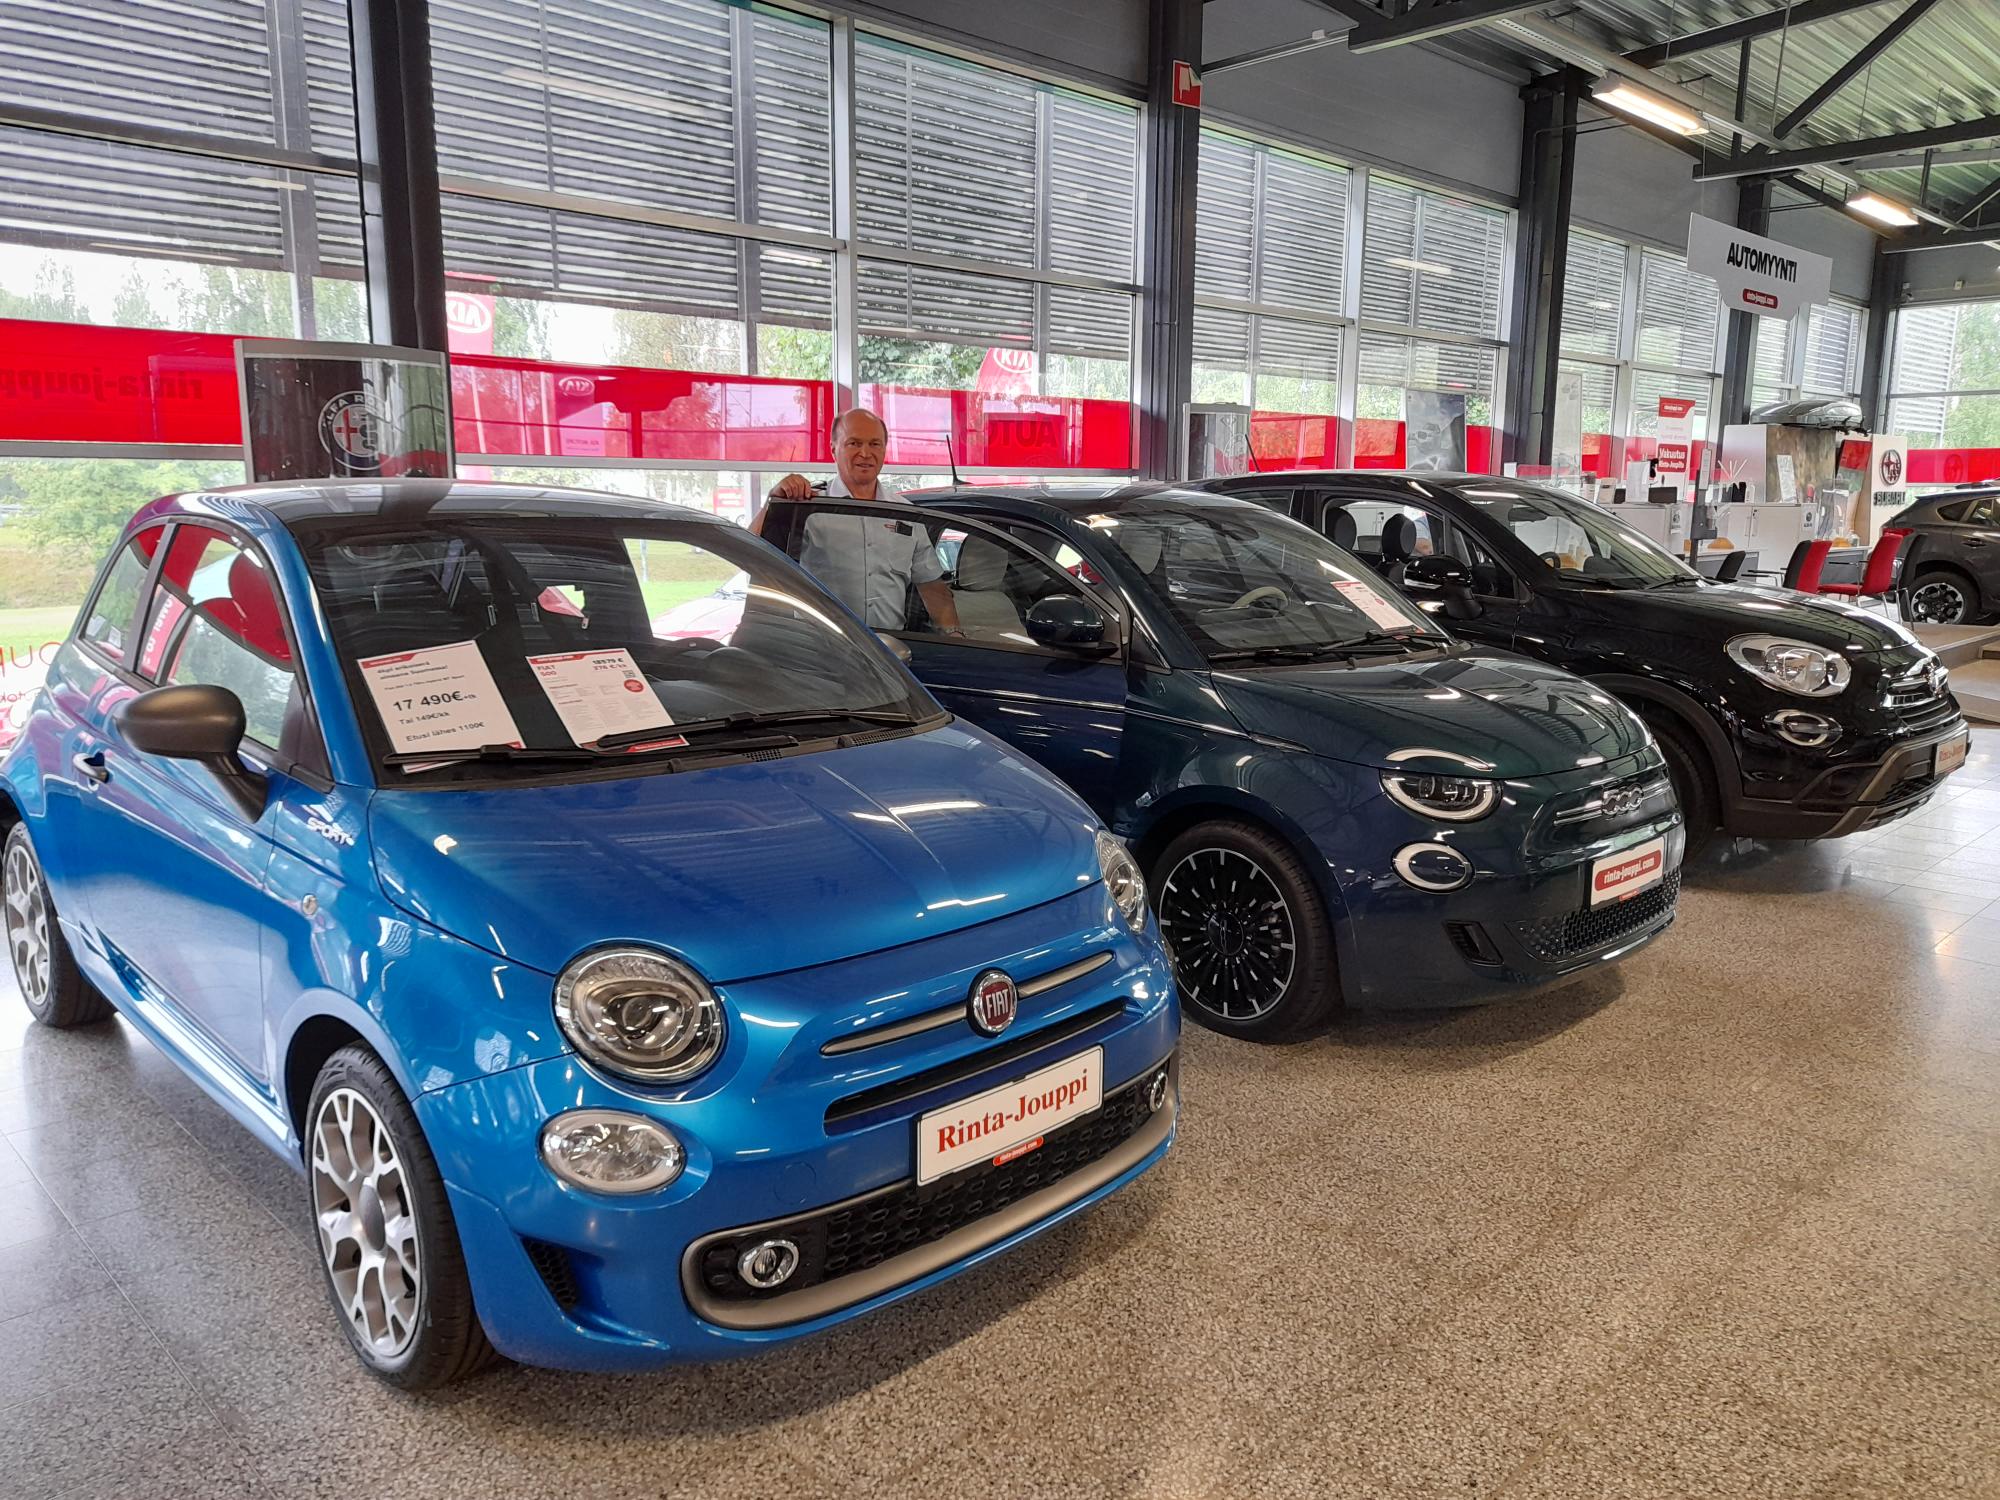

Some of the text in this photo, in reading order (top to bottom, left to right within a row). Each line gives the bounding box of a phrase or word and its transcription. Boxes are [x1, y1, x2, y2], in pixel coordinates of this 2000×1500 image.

[1727, 242, 1798, 283] AUTOMYYNTI
[1001, 349, 1030, 369] KIA
[1874, 491, 1906, 506] SUBARU
[393, 699, 412, 712] 17
[400, 718, 415, 726] Tai
[459, 721, 486, 732] 1100€
[1602, 785, 1643, 816] 500
[1604, 856, 1655, 885] rinta-jouppi.com
[986, 988, 1010, 1019] FIAT
[937, 1068, 1088, 1153] Rinta-Jouppi
